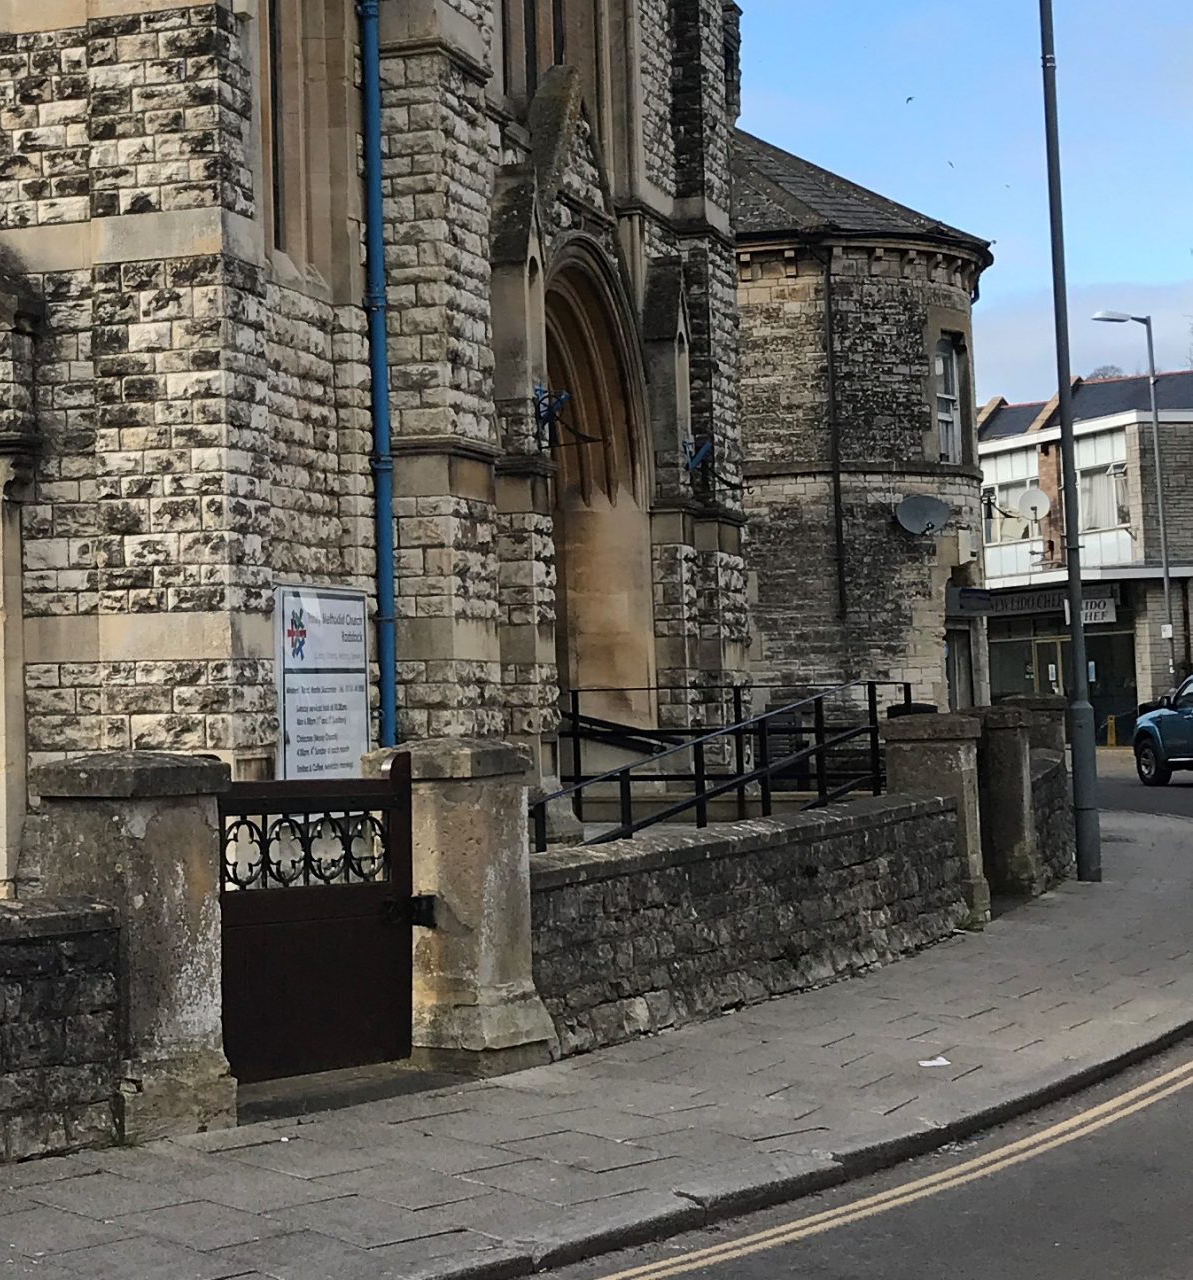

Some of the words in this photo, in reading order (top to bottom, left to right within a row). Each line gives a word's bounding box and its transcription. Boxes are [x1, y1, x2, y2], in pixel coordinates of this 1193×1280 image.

[1011, 595, 1035, 610] LIDO
[1037, 592, 1064, 609] CHEF
[1084, 599, 1107, 610] IDO
[345, 613, 363, 626] Church
[1084, 610, 1109, 621] HEF
